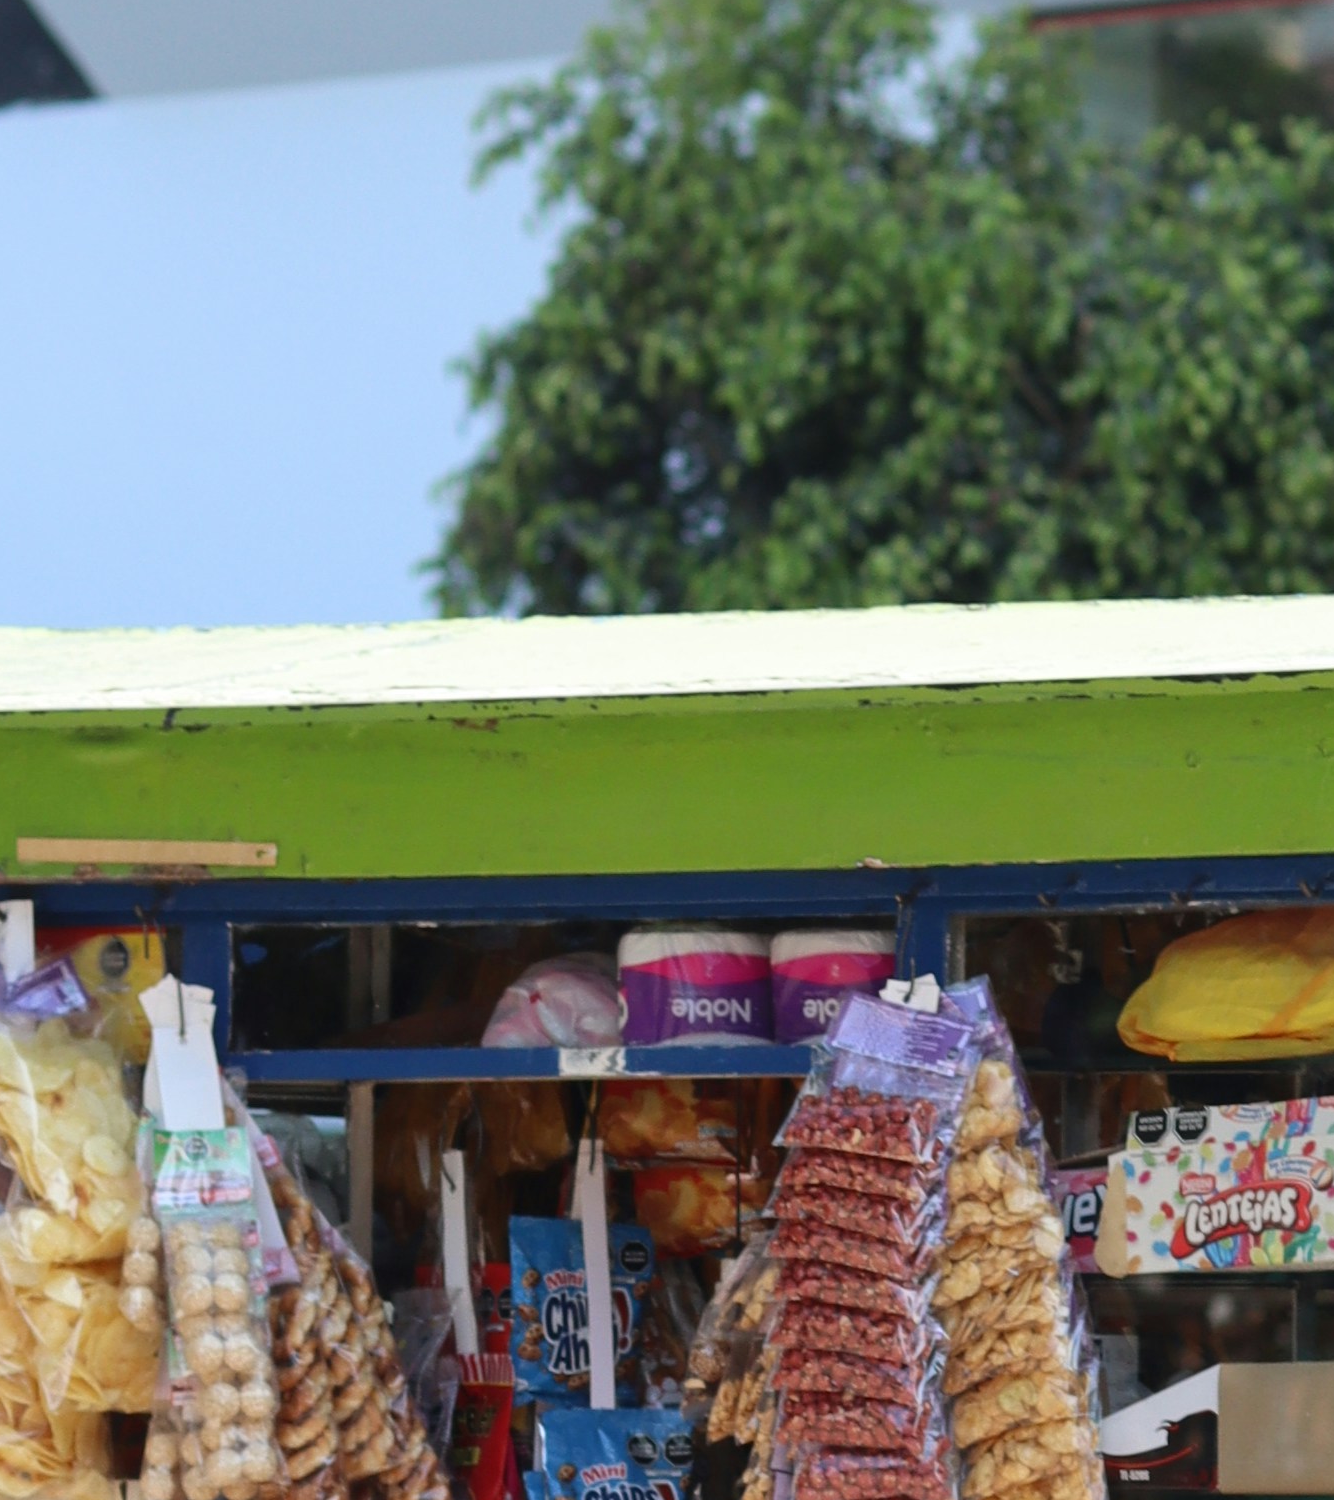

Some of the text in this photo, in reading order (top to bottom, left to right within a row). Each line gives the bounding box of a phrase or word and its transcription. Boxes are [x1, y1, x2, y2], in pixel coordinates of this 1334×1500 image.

[671, 998, 752, 1024] Noble
[543, 1288, 589, 1343] Chi
[581, 1462, 628, 1487] Mini
